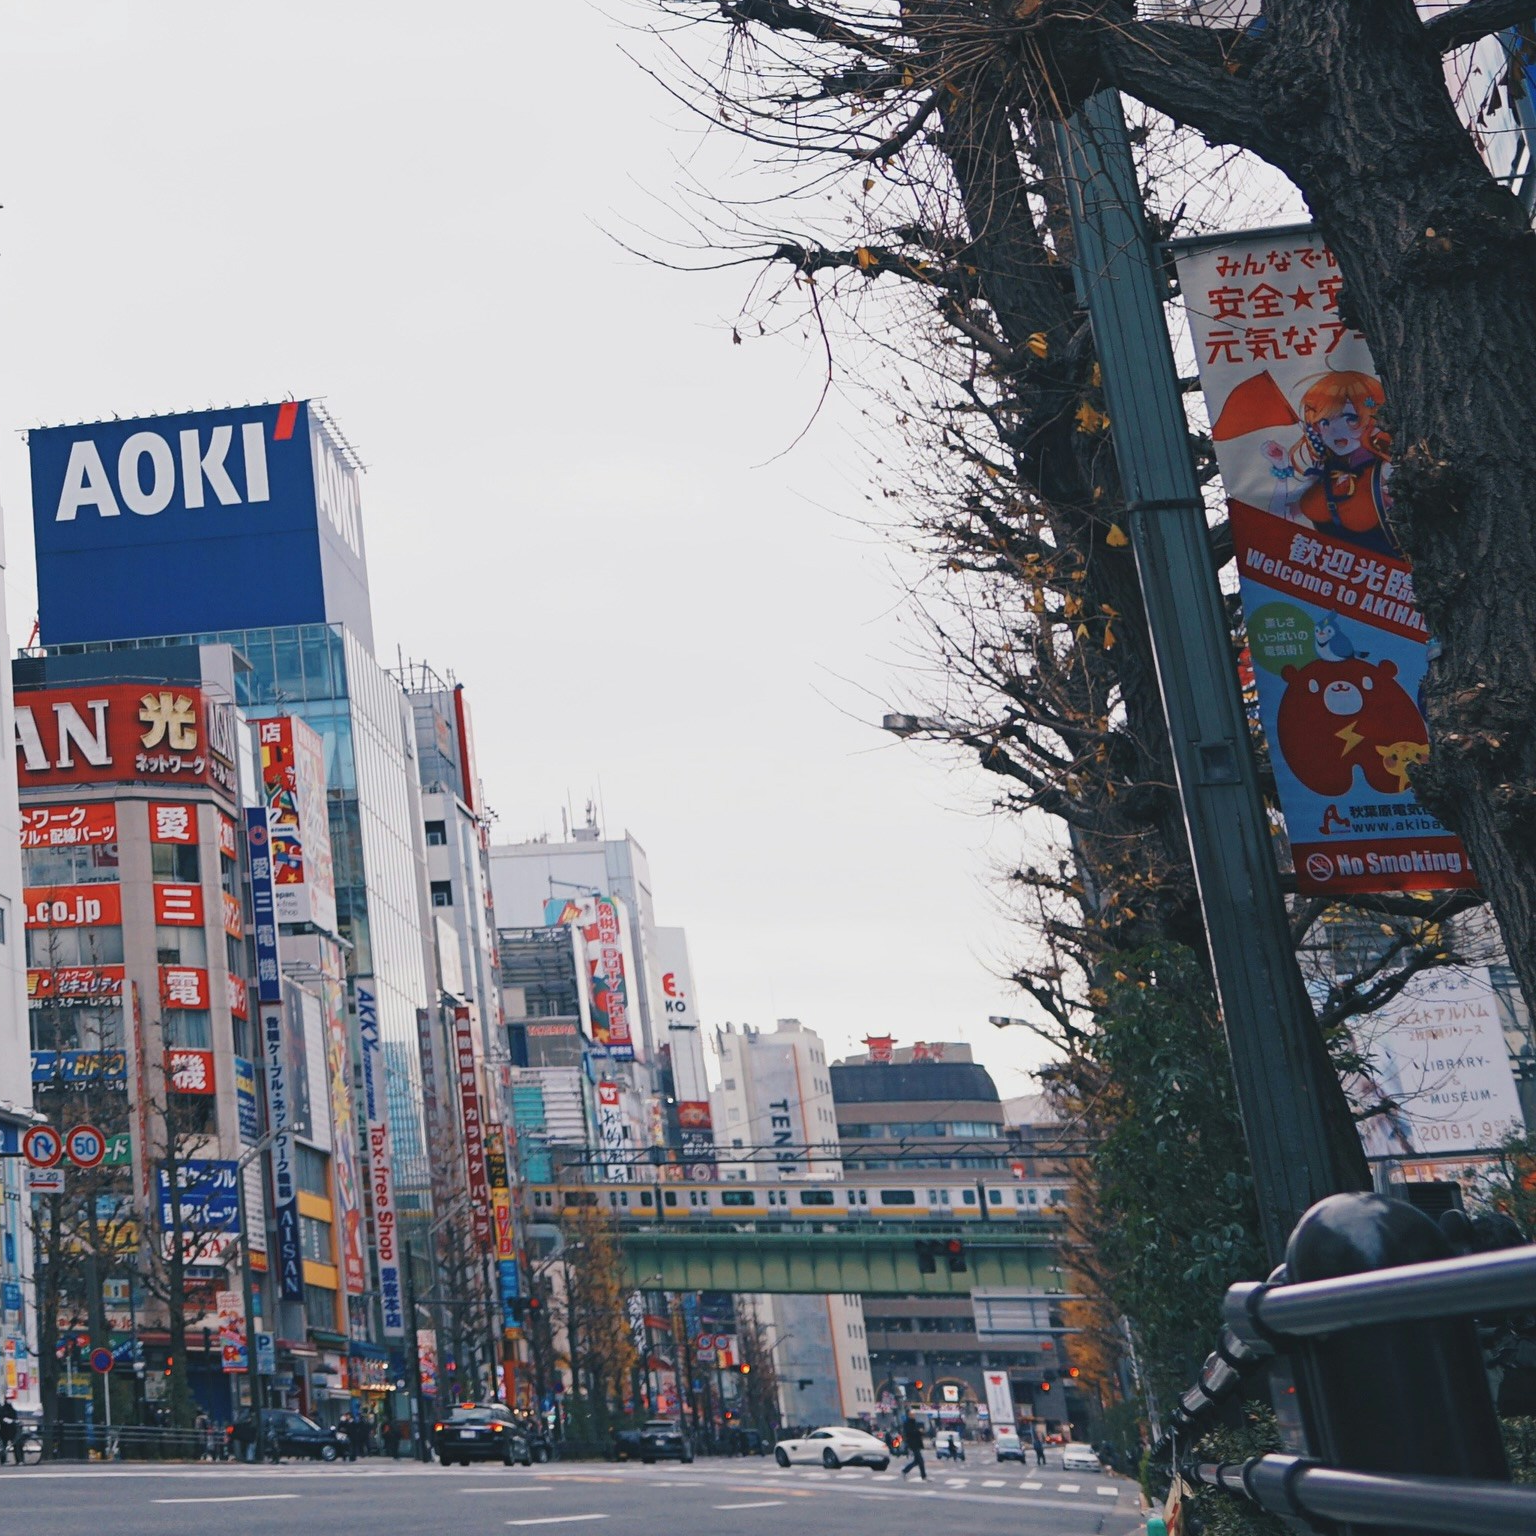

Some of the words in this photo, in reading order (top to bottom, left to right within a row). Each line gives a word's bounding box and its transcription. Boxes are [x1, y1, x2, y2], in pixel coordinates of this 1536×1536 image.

[54, 421, 271, 522] AOKI
[316, 431, 361, 560] AOKI
[1245, 547, 1334, 598] Welcome
[1336, 587, 1357, 606] to
[1257, 630, 1308, 642] いっぱいの
[138, 691, 198, 751] 光
[261, 722, 282, 744] 店
[135, 753, 206, 776] ネットワーク
[1336, 855, 1364, 876] No
[1367, 850, 1461, 875] Smoking
[251, 857, 279, 981] 愛三電機
[356, 985, 379, 1052] AKKY
[665, 1000, 686, 1013] KO
[73, 1137, 97, 1156] 50
[371, 1124, 389, 1204] Tax-free
[279, 1208, 299, 1293] AISAN
[378, 1209, 393, 1262] Shop
[497, 1204, 513, 1254] DVD
[258, 1333, 270, 1352] P
